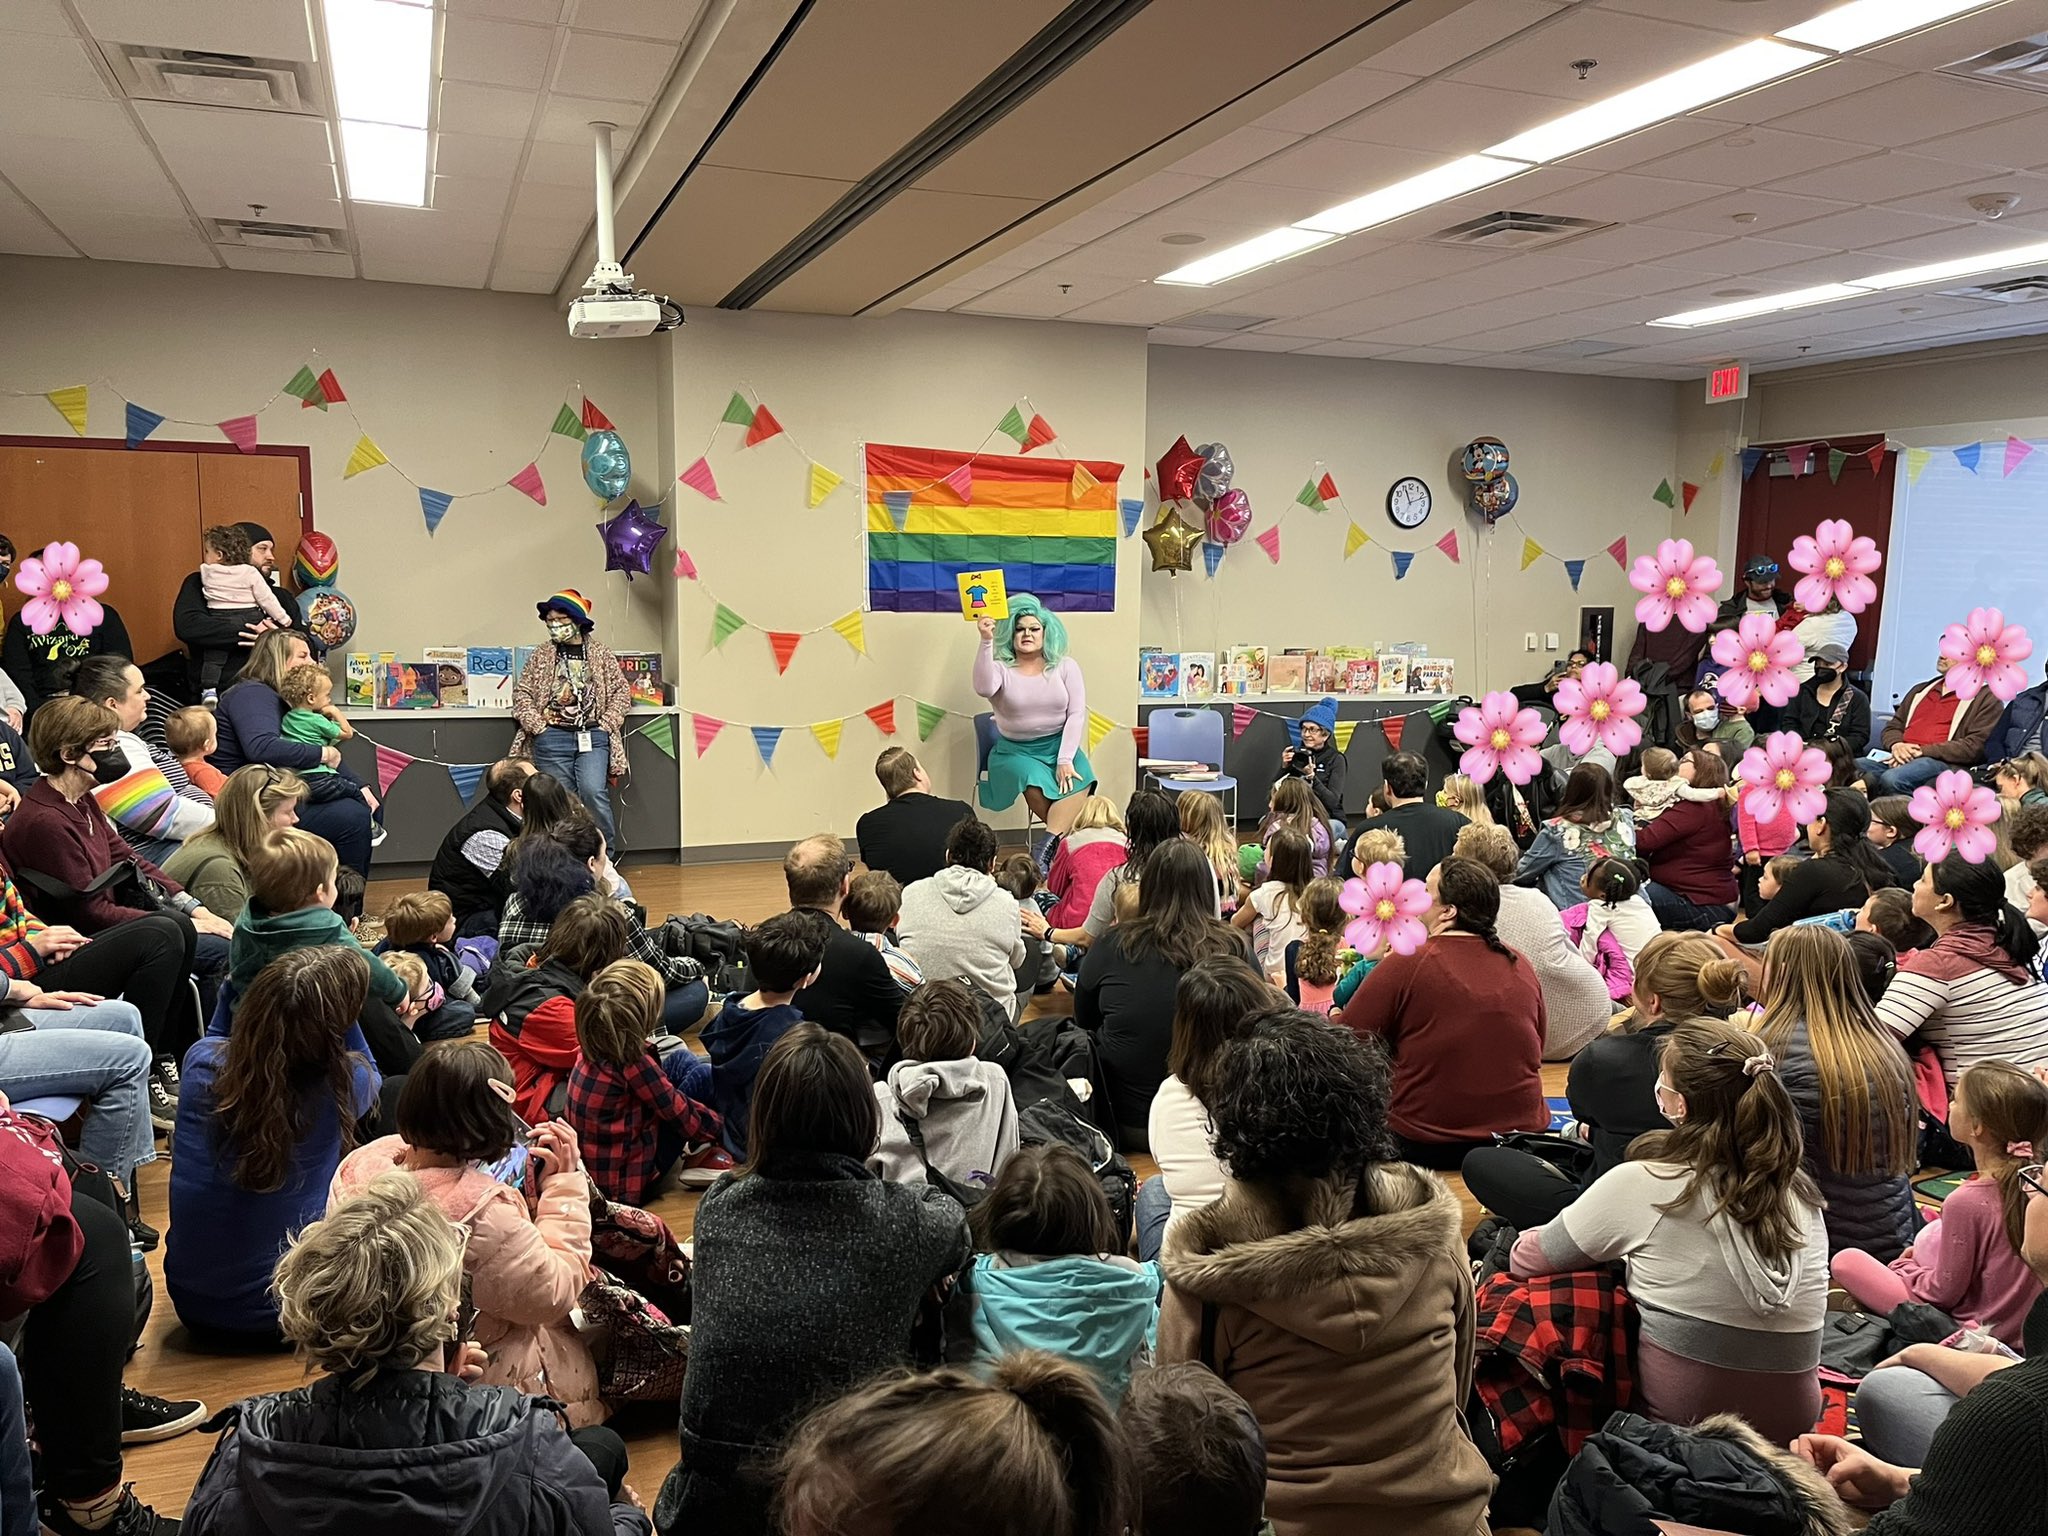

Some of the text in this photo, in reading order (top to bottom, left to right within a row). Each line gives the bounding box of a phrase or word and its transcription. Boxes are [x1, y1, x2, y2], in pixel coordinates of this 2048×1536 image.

[1711, 367, 1740, 398] EXIT
[472, 656, 509, 672] Red
[618, 660, 657, 671] PRIDE
